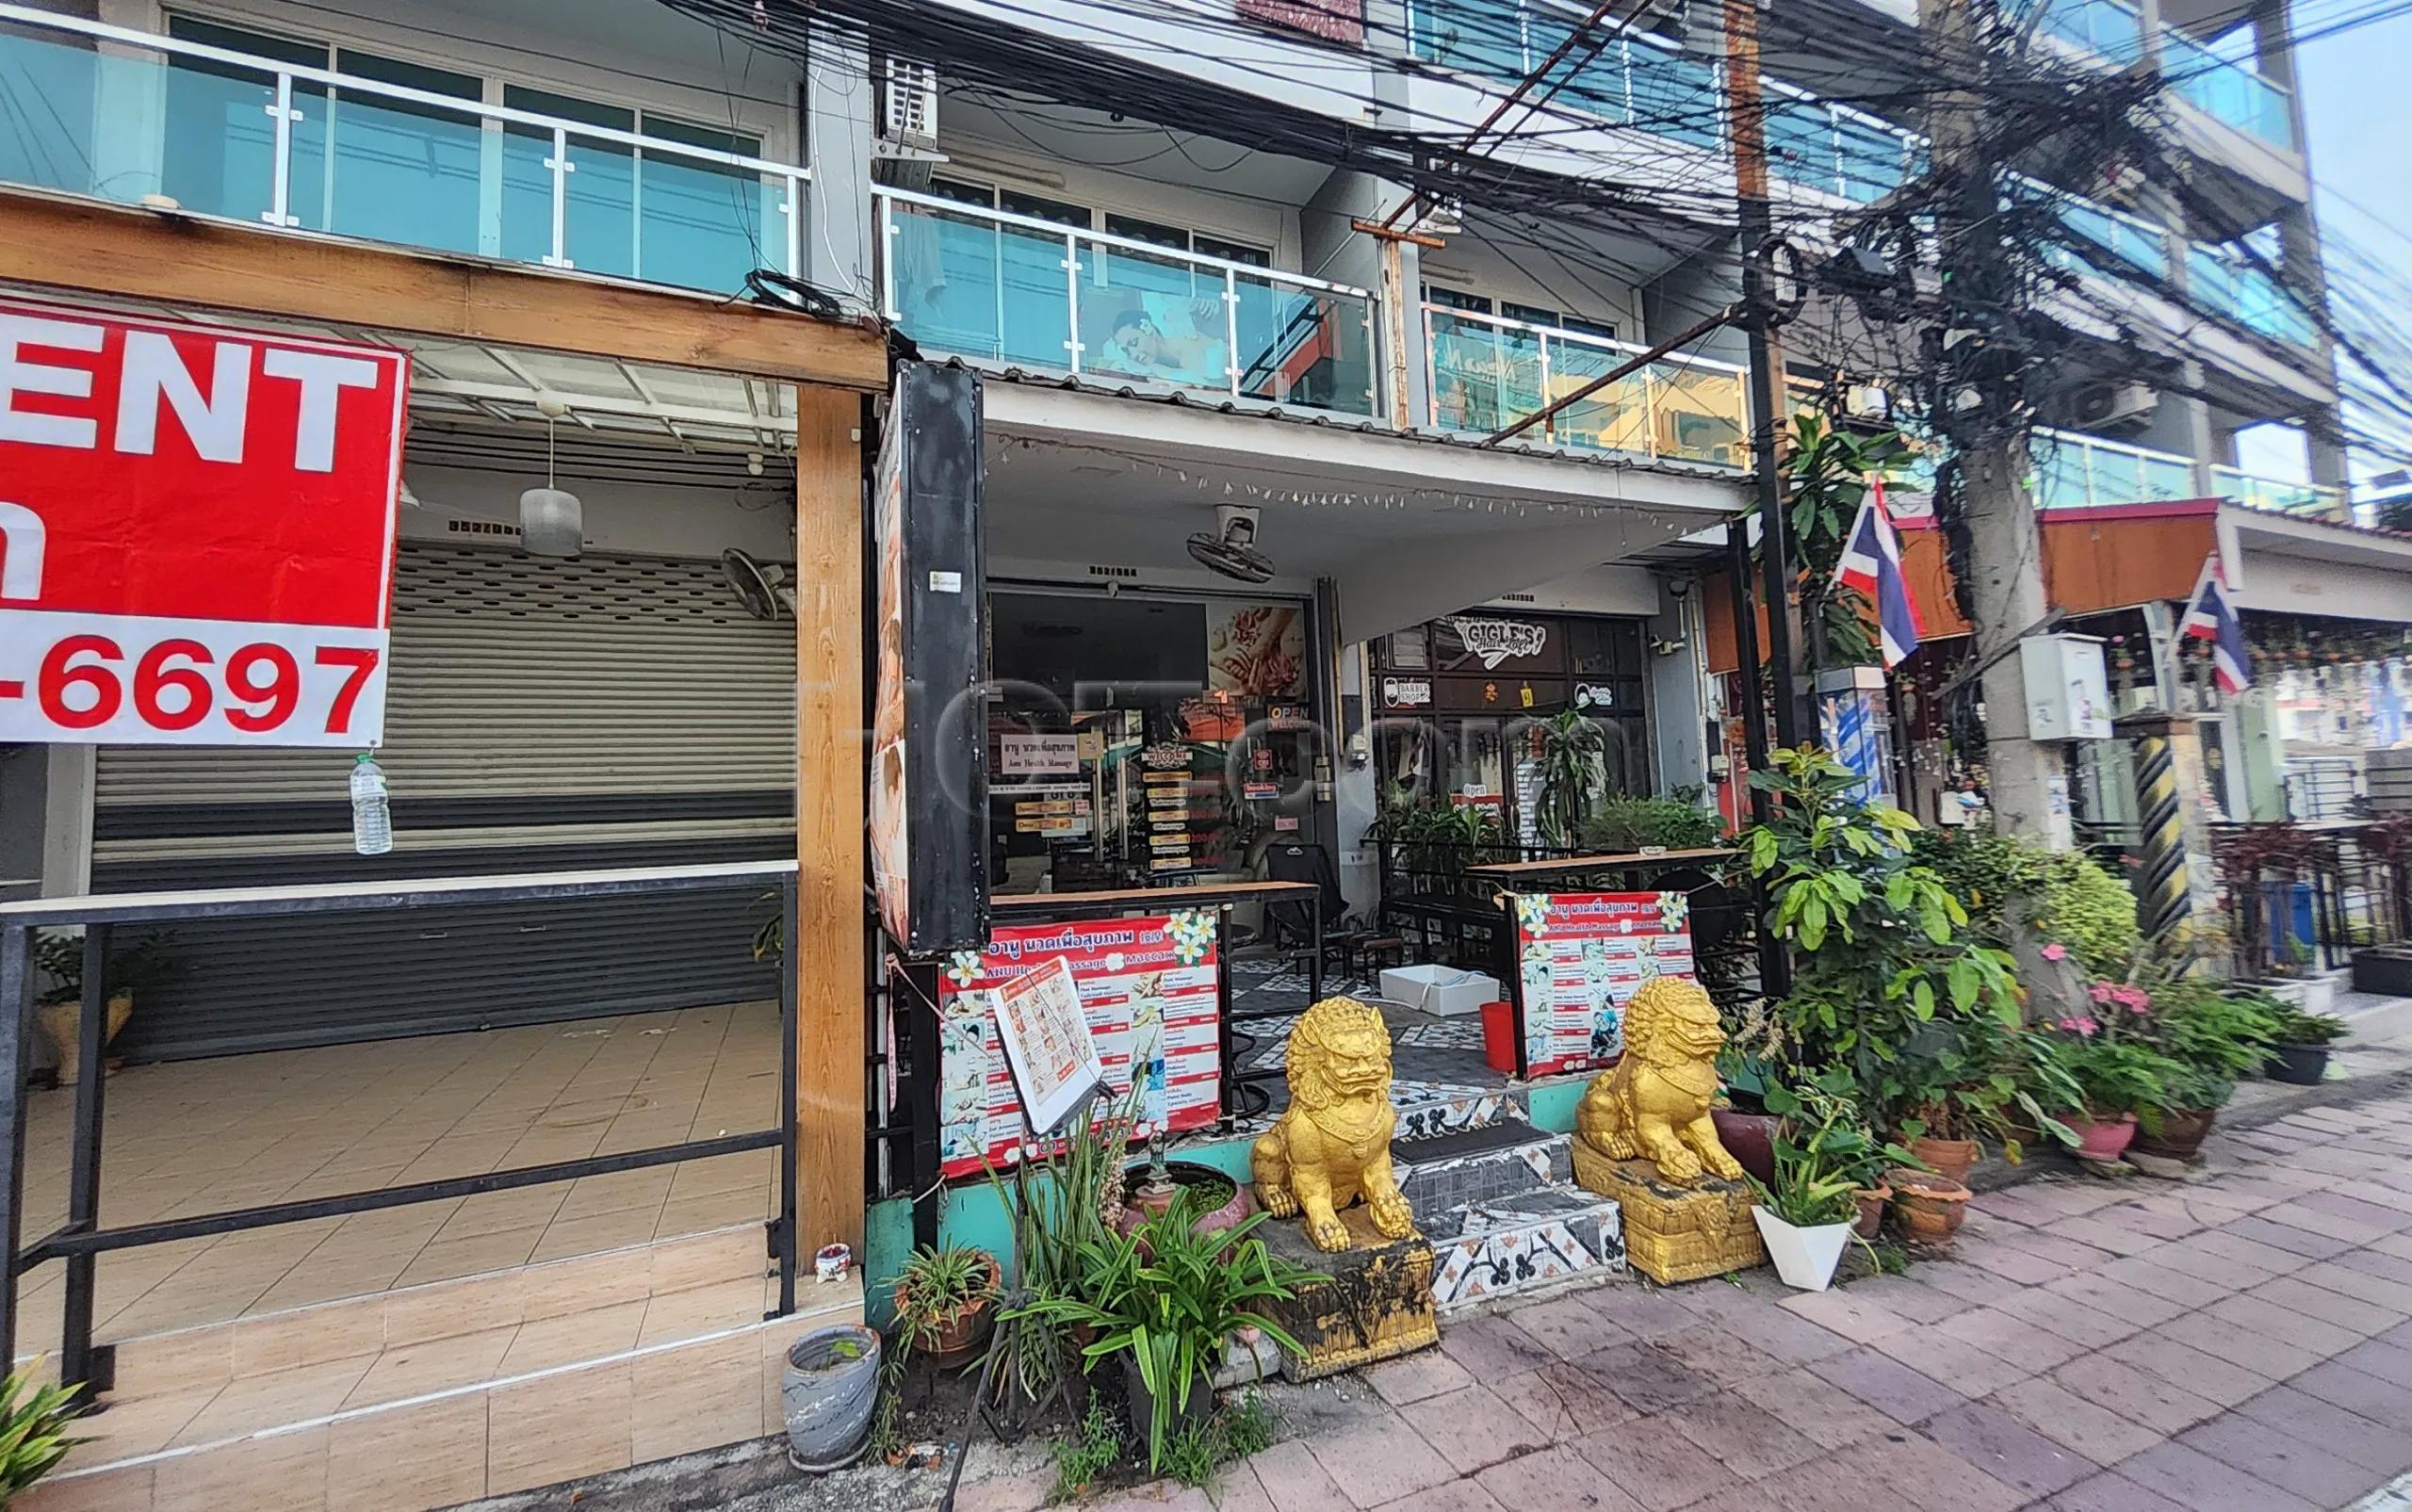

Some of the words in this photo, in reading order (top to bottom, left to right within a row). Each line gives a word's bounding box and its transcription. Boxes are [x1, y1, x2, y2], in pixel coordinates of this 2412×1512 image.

[1400, 684, 1428, 692] BARBER
[1271, 707, 1310, 719] OPEN
[1463, 785, 1486, 797] Open
[989, 941, 1020, 958] อานู
[1024, 928, 1133, 953] นวดเพื่อสุขภาพ
[986, 967, 1012, 978] ANU
[1069, 958, 1107, 971] assage
